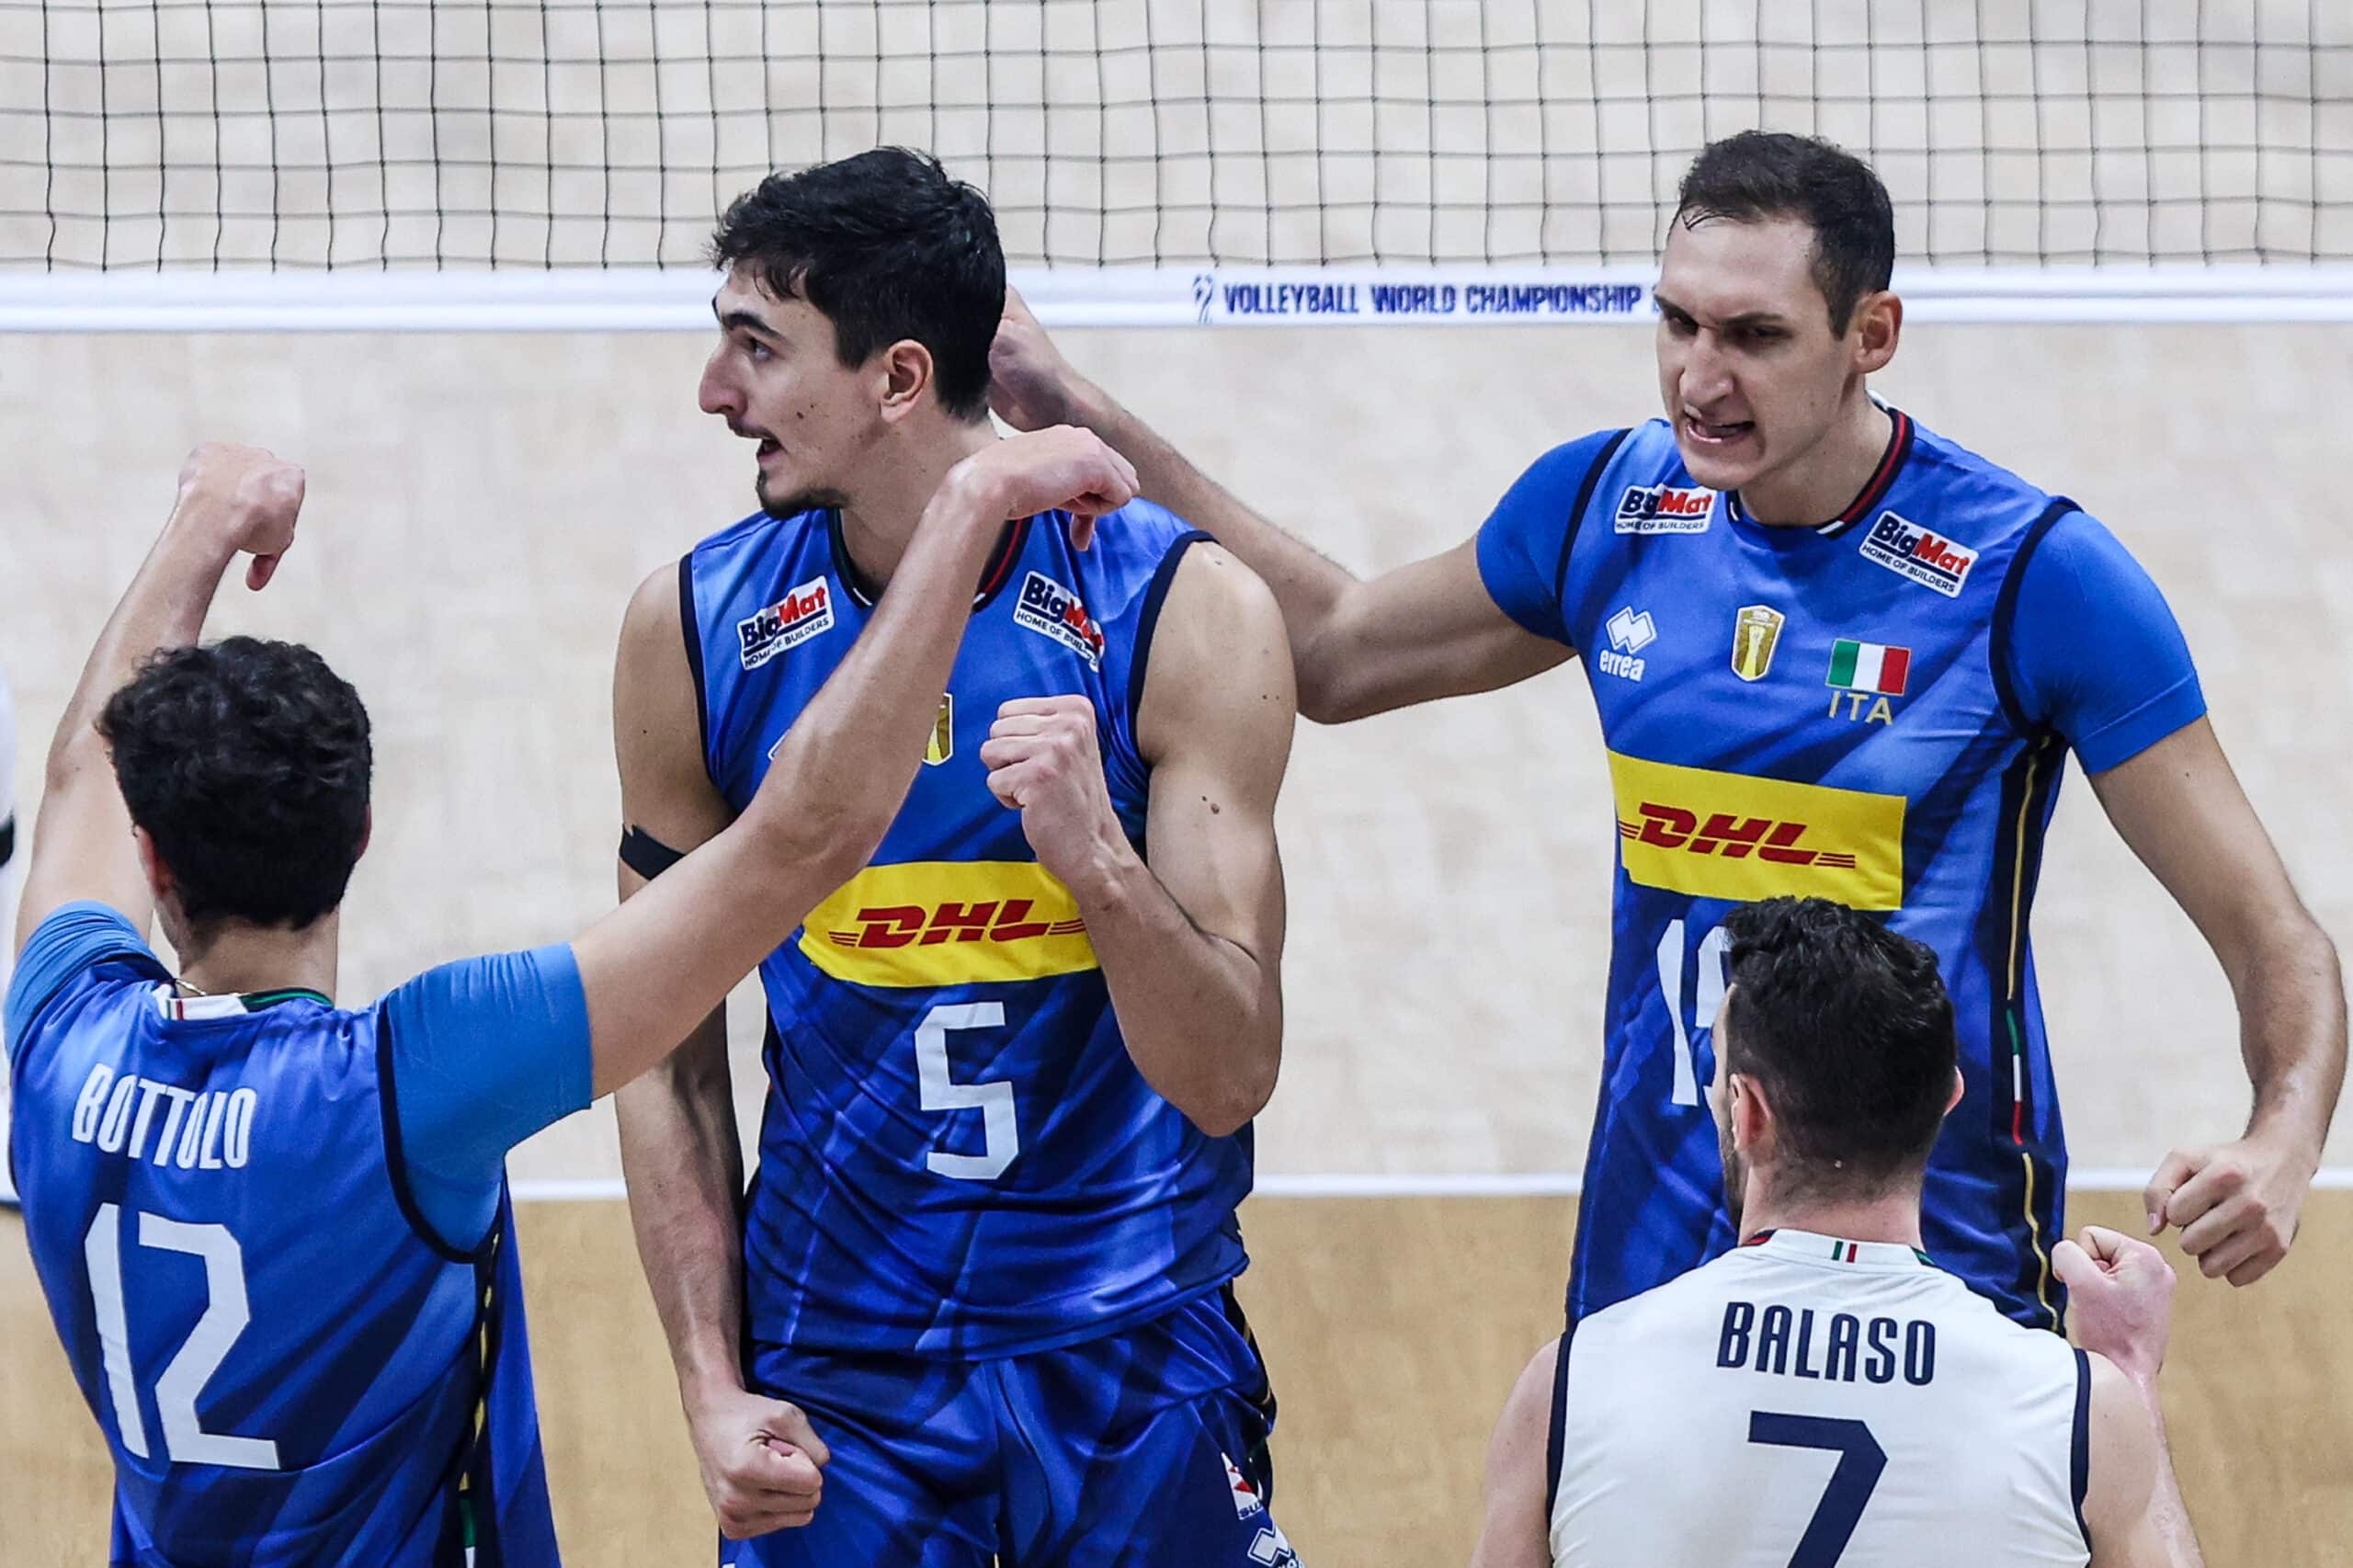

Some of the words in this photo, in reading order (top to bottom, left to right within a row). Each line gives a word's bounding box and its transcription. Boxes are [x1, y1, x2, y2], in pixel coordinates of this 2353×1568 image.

[1224, 284, 1359, 313] VOLLEYBALL
[1370, 284, 1456, 314] WORLD
[1465, 284, 1642, 314] CHAMPIONSHIP
[1643, 522, 1656, 530] OF
[1658, 520, 1705, 529] BUILDERS
[1872, 514, 1970, 574] BigMat
[1861, 544, 1892, 565] HOME
[1893, 557, 1907, 569] OF
[1907, 566, 1956, 593] BUILDERS
[784, 617, 829, 645] BUILDERS
[1017, 611, 1048, 631] HOME
[1049, 625, 1063, 636] OF
[1828, 690, 1893, 726] ITA
[1640, 801, 1819, 866] DHL
[857, 899, 1051, 949] DHL
[72, 1062, 257, 1170] BOTTOLO
[915, 1001, 1019, 1180] 5
[84, 1202, 281, 1471] 12
[1716, 1301, 1937, 1386] BALASO
[1748, 1410, 1889, 1568] 7
